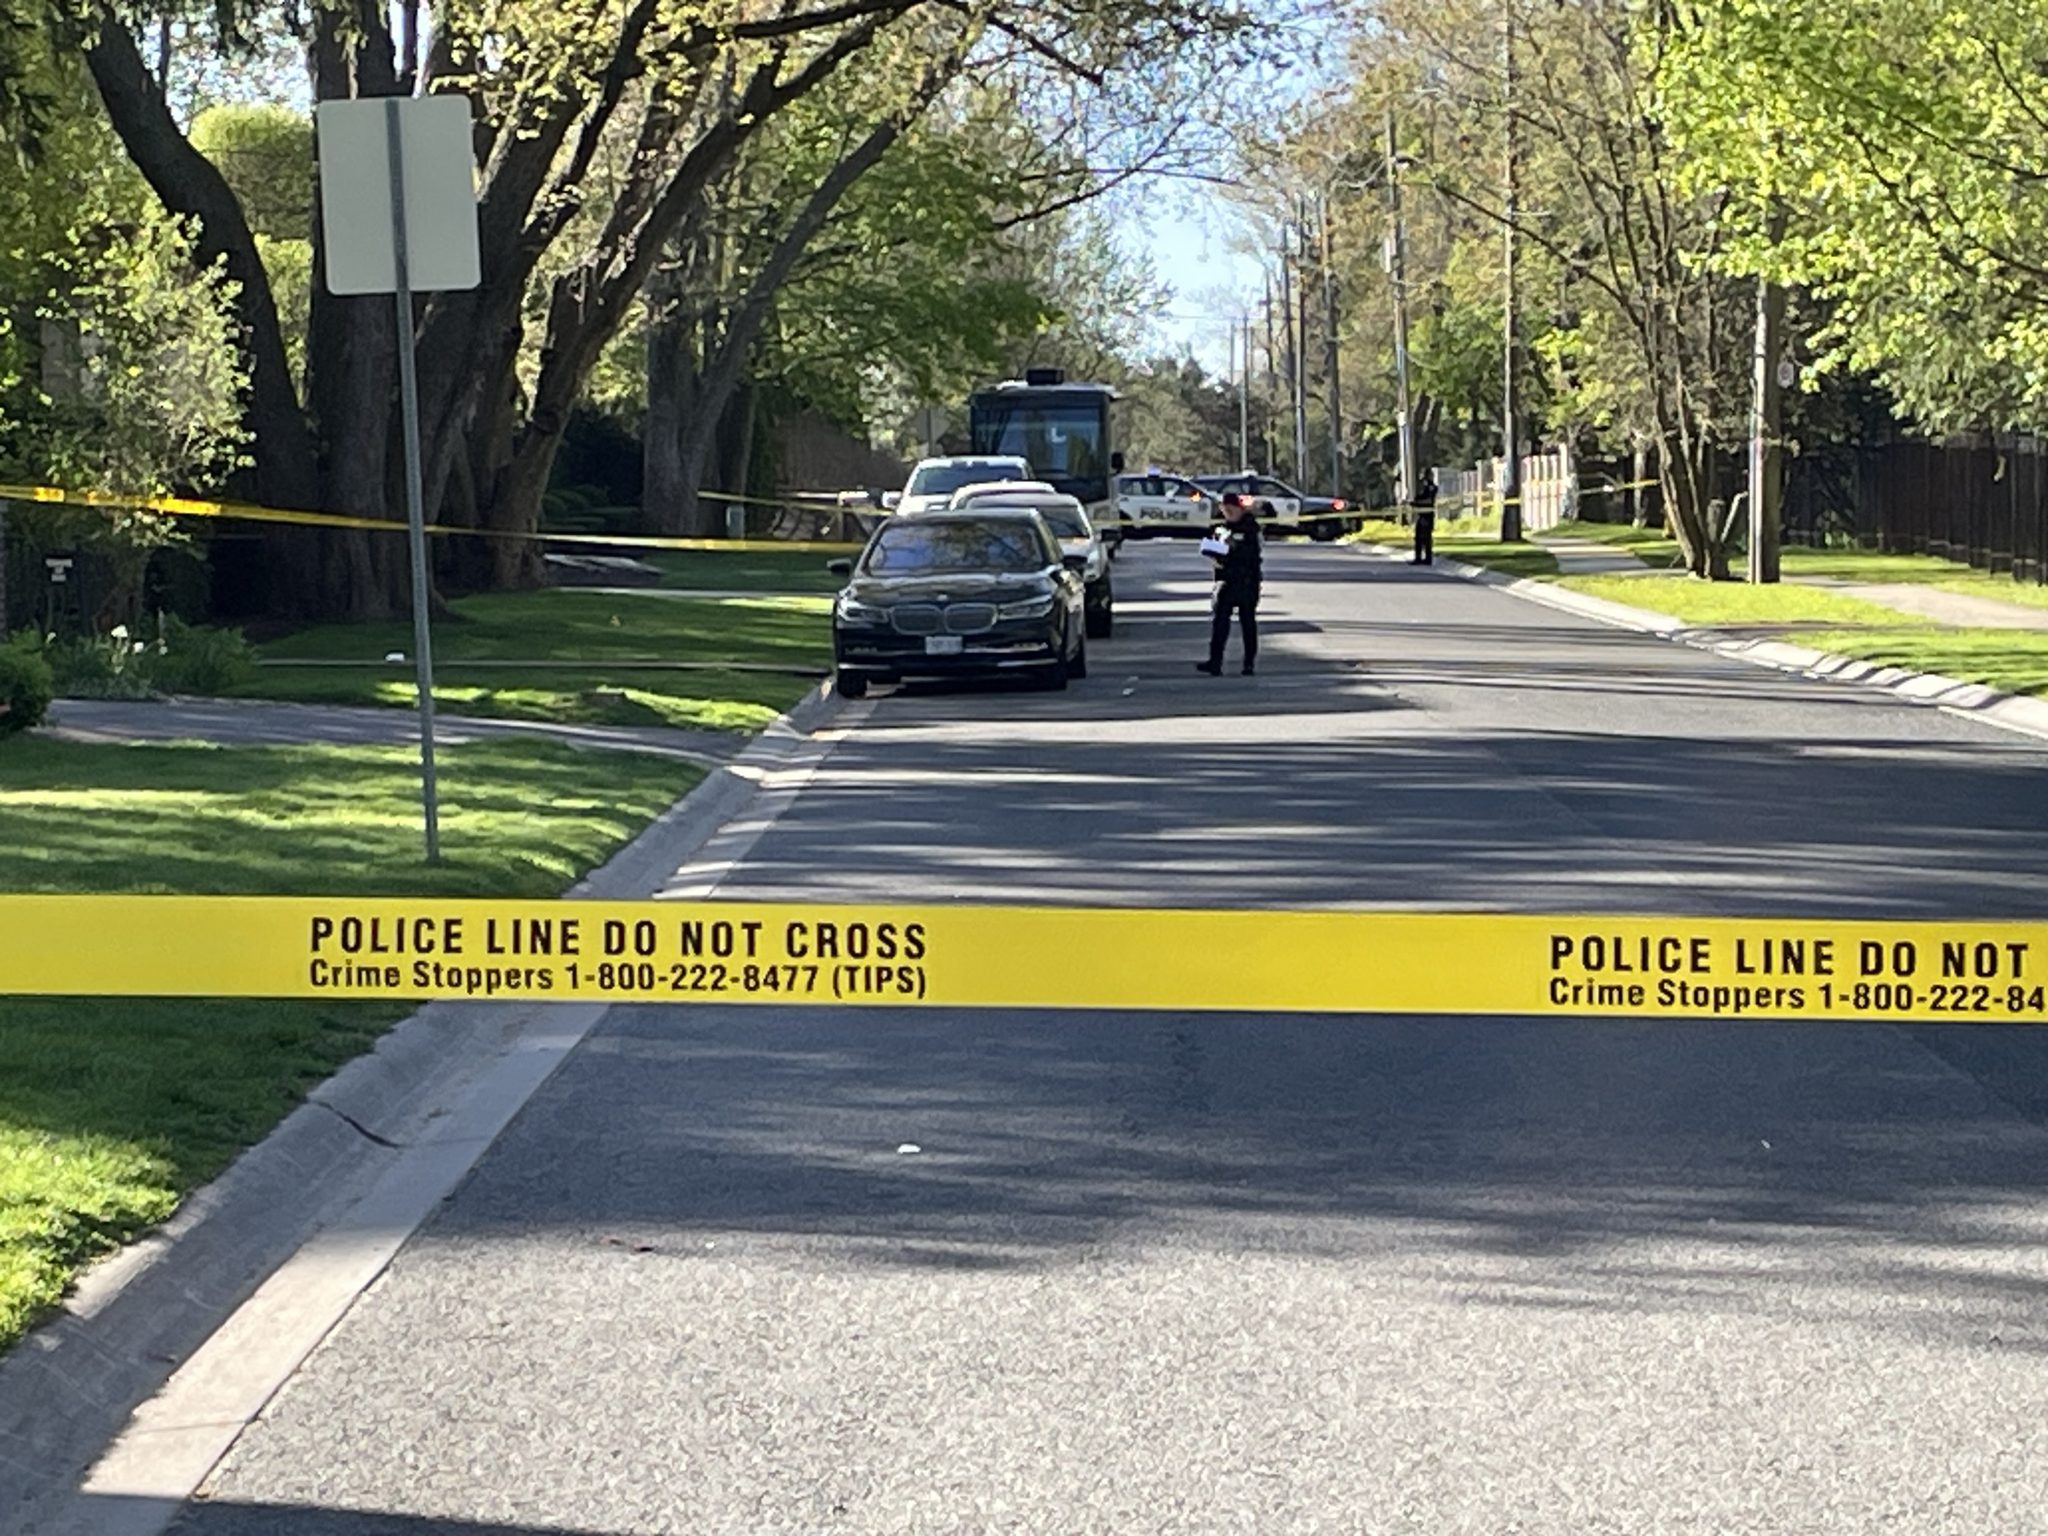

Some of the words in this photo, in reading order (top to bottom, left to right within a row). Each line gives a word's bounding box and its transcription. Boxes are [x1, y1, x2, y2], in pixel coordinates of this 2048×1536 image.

[1140, 506, 1189, 520] POLICE
[311, 916, 463, 954] POLICE
[487, 918, 580, 956] LINE
[604, 920, 656, 957] DO
[681, 921, 763, 958] NOT
[786, 922, 926, 960] CROSS
[1551, 935, 1711, 974] POLICE
[1736, 938, 1834, 976] LINE
[1860, 940, 1916, 977] DO
[1942, 942, 2029, 979] NOT
[310, 957, 401, 989] Crime
[413, 960, 553, 995] Stoppers
[565, 961, 820, 992] 1-800-222-8477
[832, 964, 926, 1000] (TIPS)
[1550, 976, 1645, 1007] Crime
[1657, 978, 1805, 1014] Stoppers
